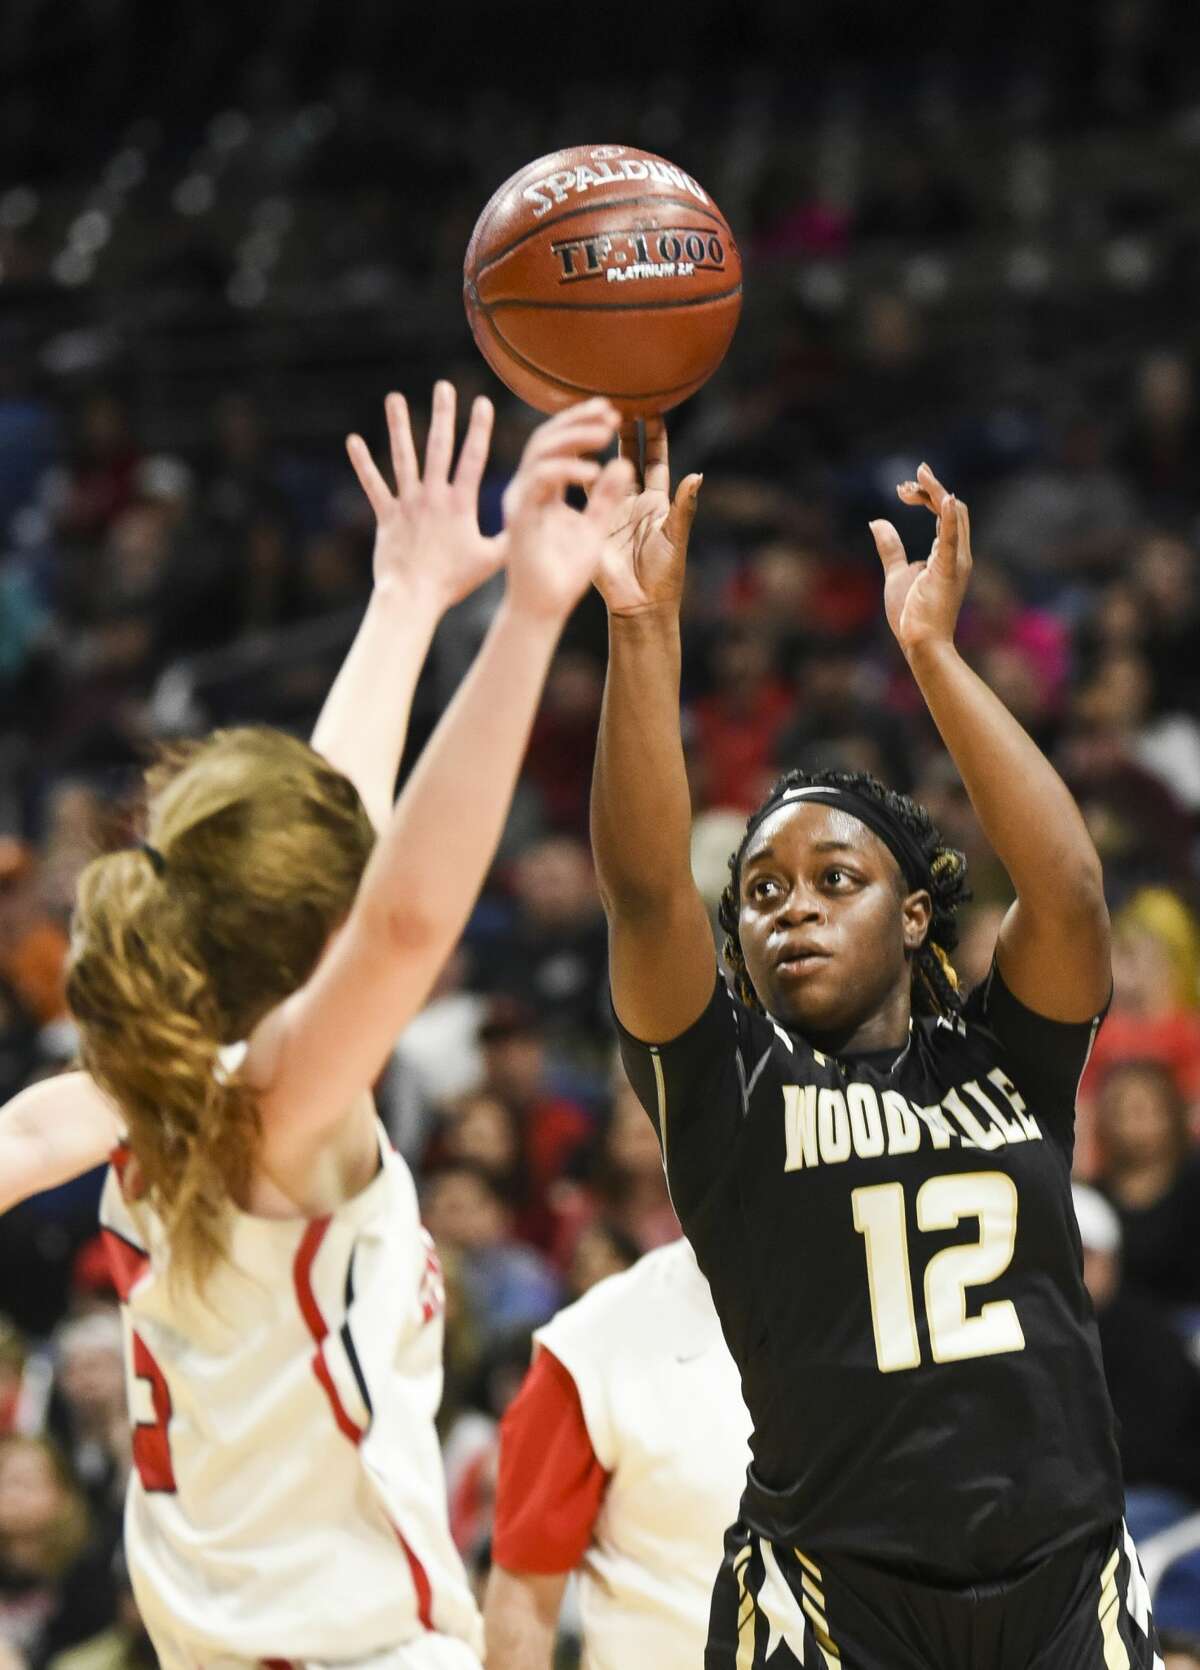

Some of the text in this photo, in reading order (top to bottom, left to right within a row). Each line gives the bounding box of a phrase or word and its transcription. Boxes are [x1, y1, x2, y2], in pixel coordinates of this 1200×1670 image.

[523, 159, 709, 217] SPALDING
[606, 263, 675, 282] PLATINUM
[851, 1171, 1026, 1373] 12
